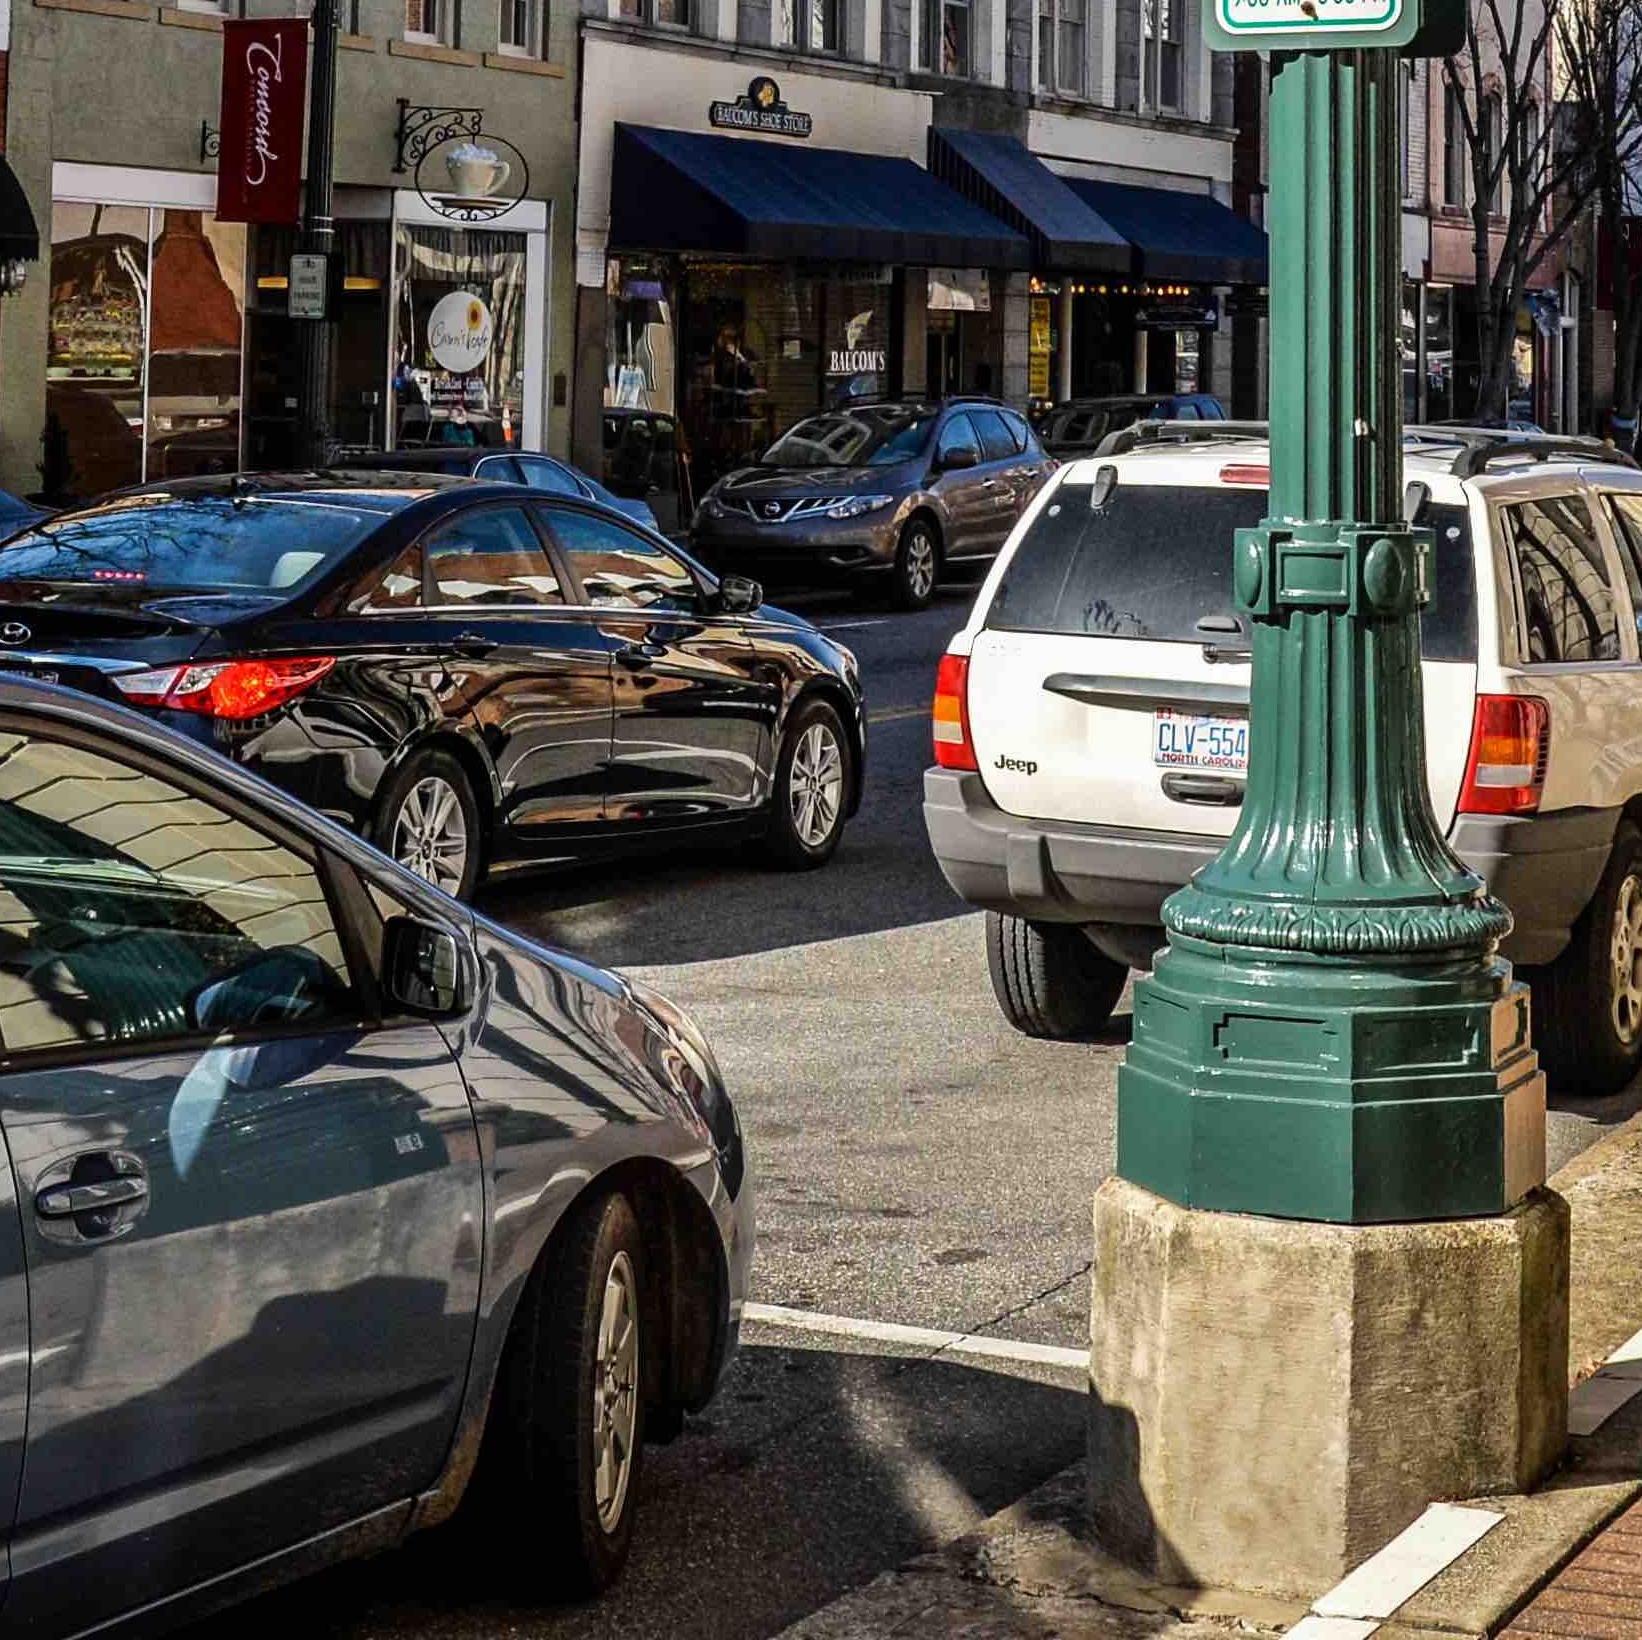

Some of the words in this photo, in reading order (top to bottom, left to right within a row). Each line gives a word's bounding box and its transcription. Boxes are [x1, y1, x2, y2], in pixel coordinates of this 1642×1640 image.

[830, 350, 886, 372] BAUCOM'S
[1158, 722, 1246, 757] CLV-554
[994, 754, 1038, 776] Jeep
[1161, 752, 1199, 766] NORTH
[1202, 755, 1247, 769] CAROLIN
